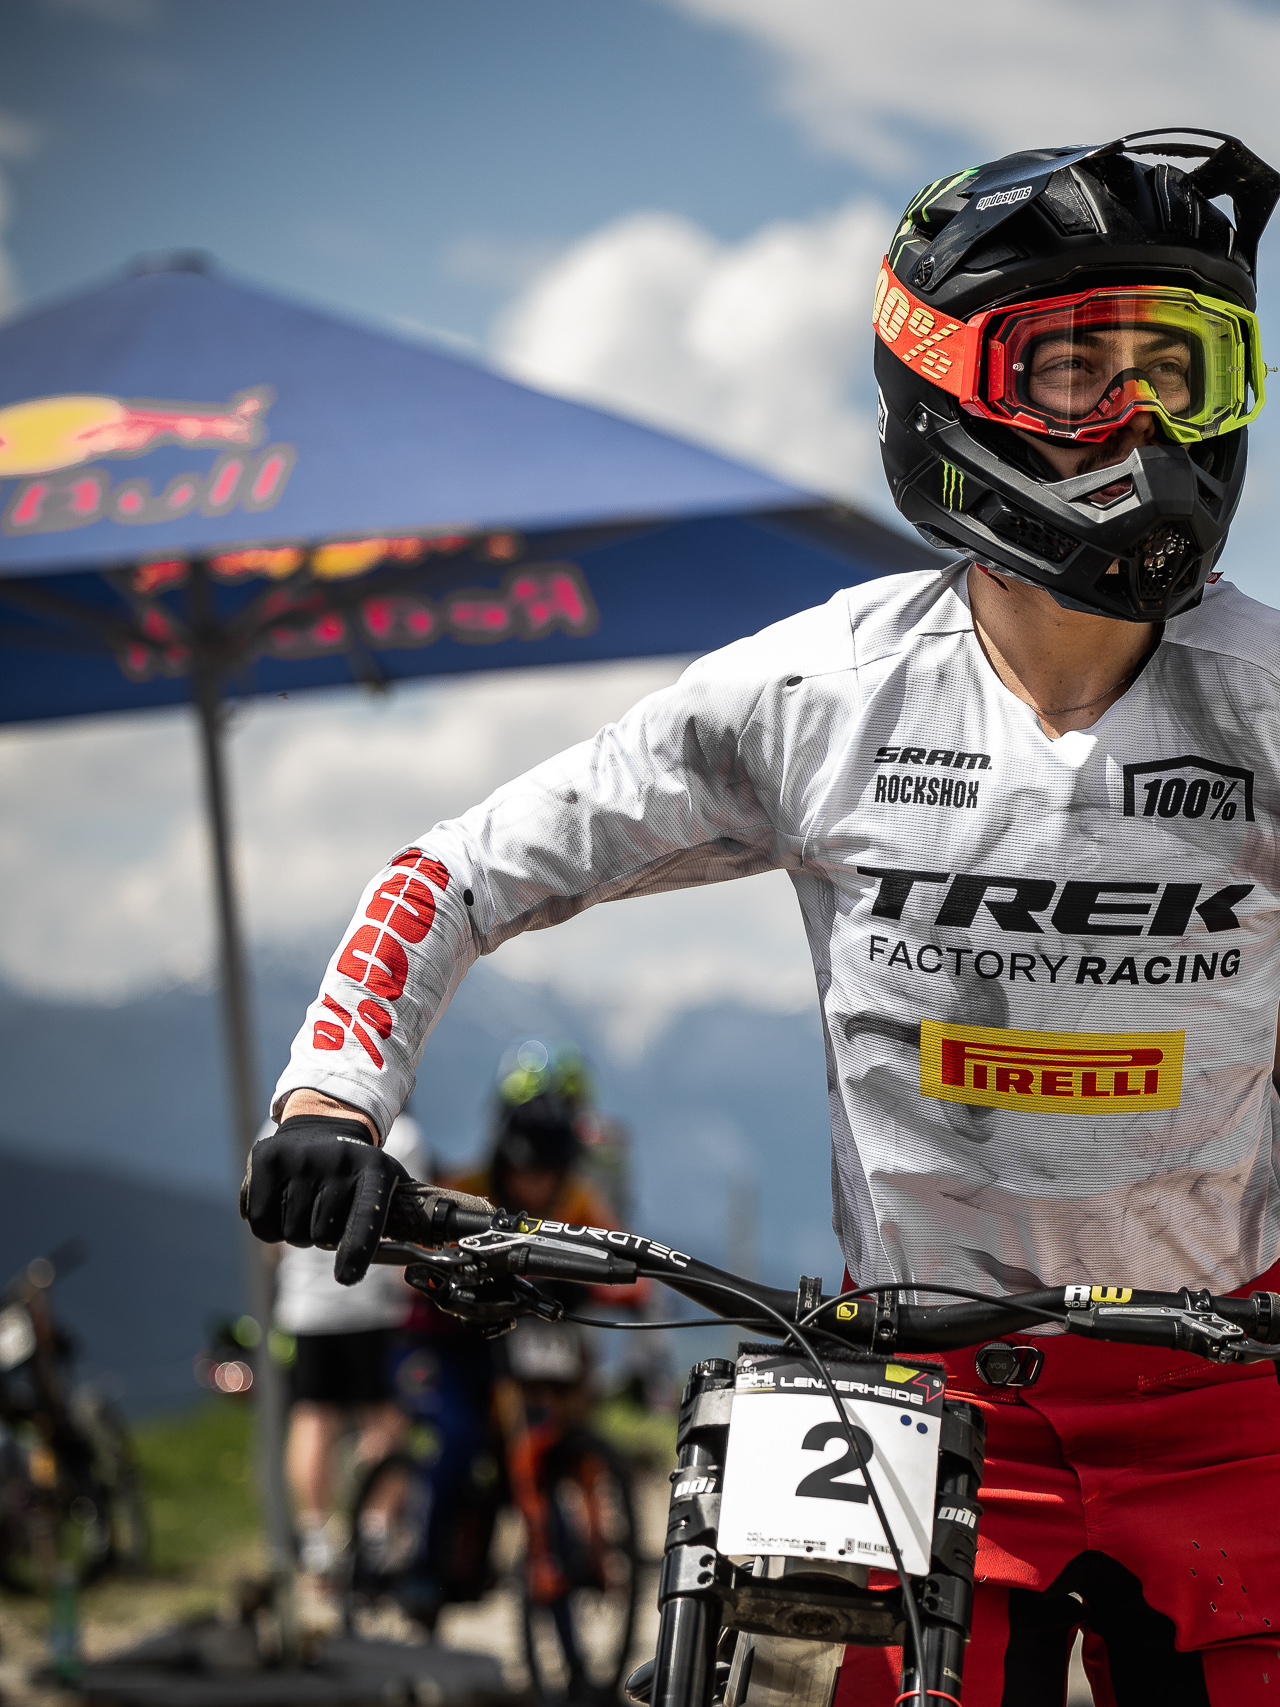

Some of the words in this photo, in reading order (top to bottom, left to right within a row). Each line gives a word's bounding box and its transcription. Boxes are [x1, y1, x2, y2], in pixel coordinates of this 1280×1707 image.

[977, 185, 1032, 211] apdesigns
[875, 775, 979, 808] ROCKSHOX
[1142, 777, 1238, 821] 100%
[857, 866, 1256, 936] TREK
[869, 935, 1069, 983] FACTORY
[1075, 948, 1241, 985] RACING
[941, 1038, 1164, 1097] PIRELLI
[540, 1219, 692, 1268] BURGTEC
[795, 1421, 874, 1504] 2
